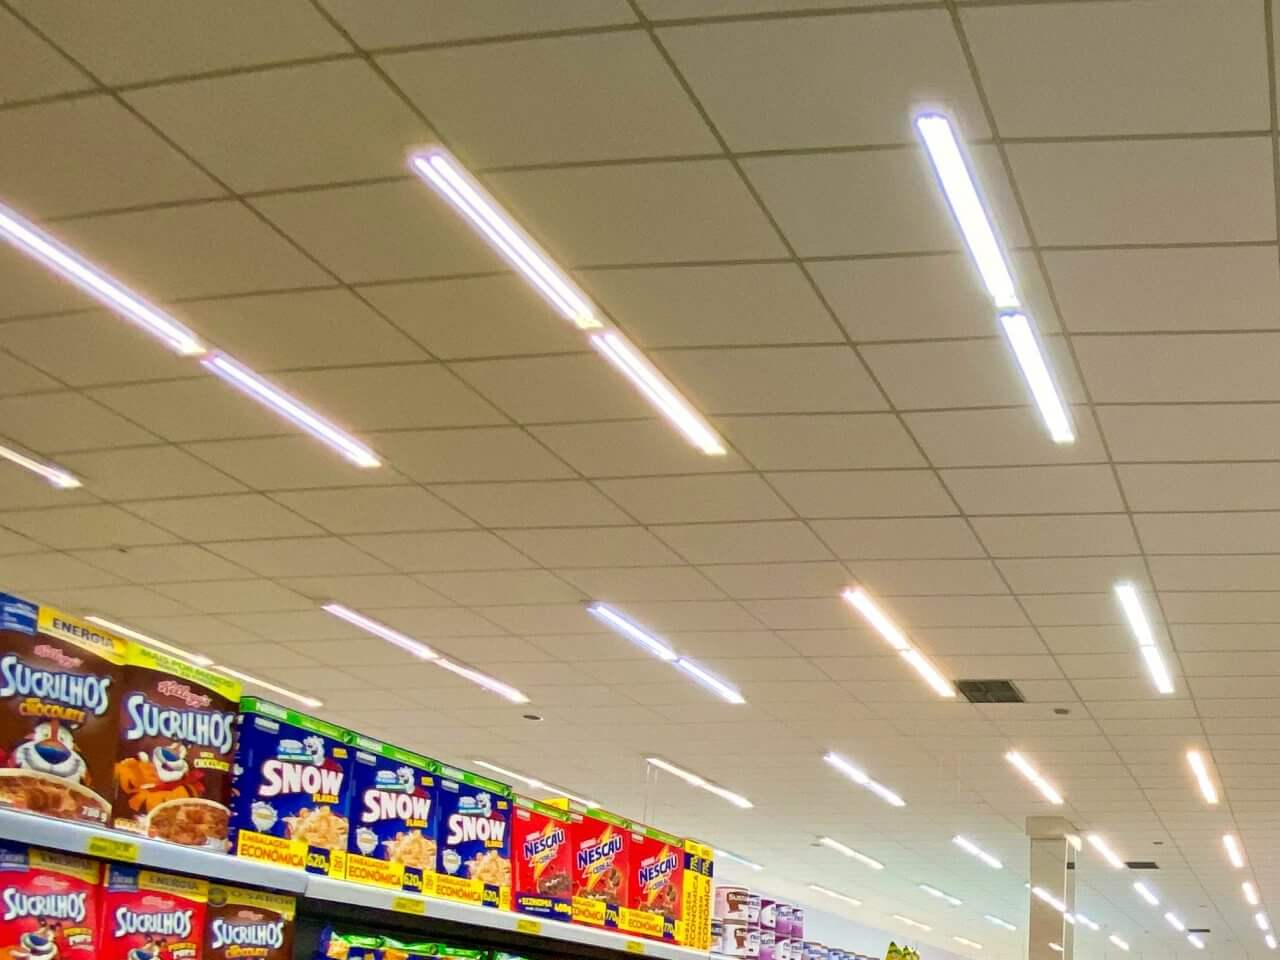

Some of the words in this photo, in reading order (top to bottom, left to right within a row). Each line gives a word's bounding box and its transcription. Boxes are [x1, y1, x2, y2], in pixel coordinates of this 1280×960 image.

[52, 616, 116, 650] ENERGIA
[0, 656, 112, 715] SUCRILHOS
[126, 695, 236, 754] SUCRILHOS
[259, 761, 344, 797] SNOW
[361, 789, 432, 823] SNOW
[448, 814, 506, 845] SNOW
[523, 829, 566, 860] NESCAU
[577, 837, 622, 870] NESCAU
[638, 856, 679, 887] NESCAU
[3, 889, 86, 922] SUCRILHOS
[115, 907, 193, 939] SUCRILHOS
[212, 919, 284, 950] SUCRILHOS
